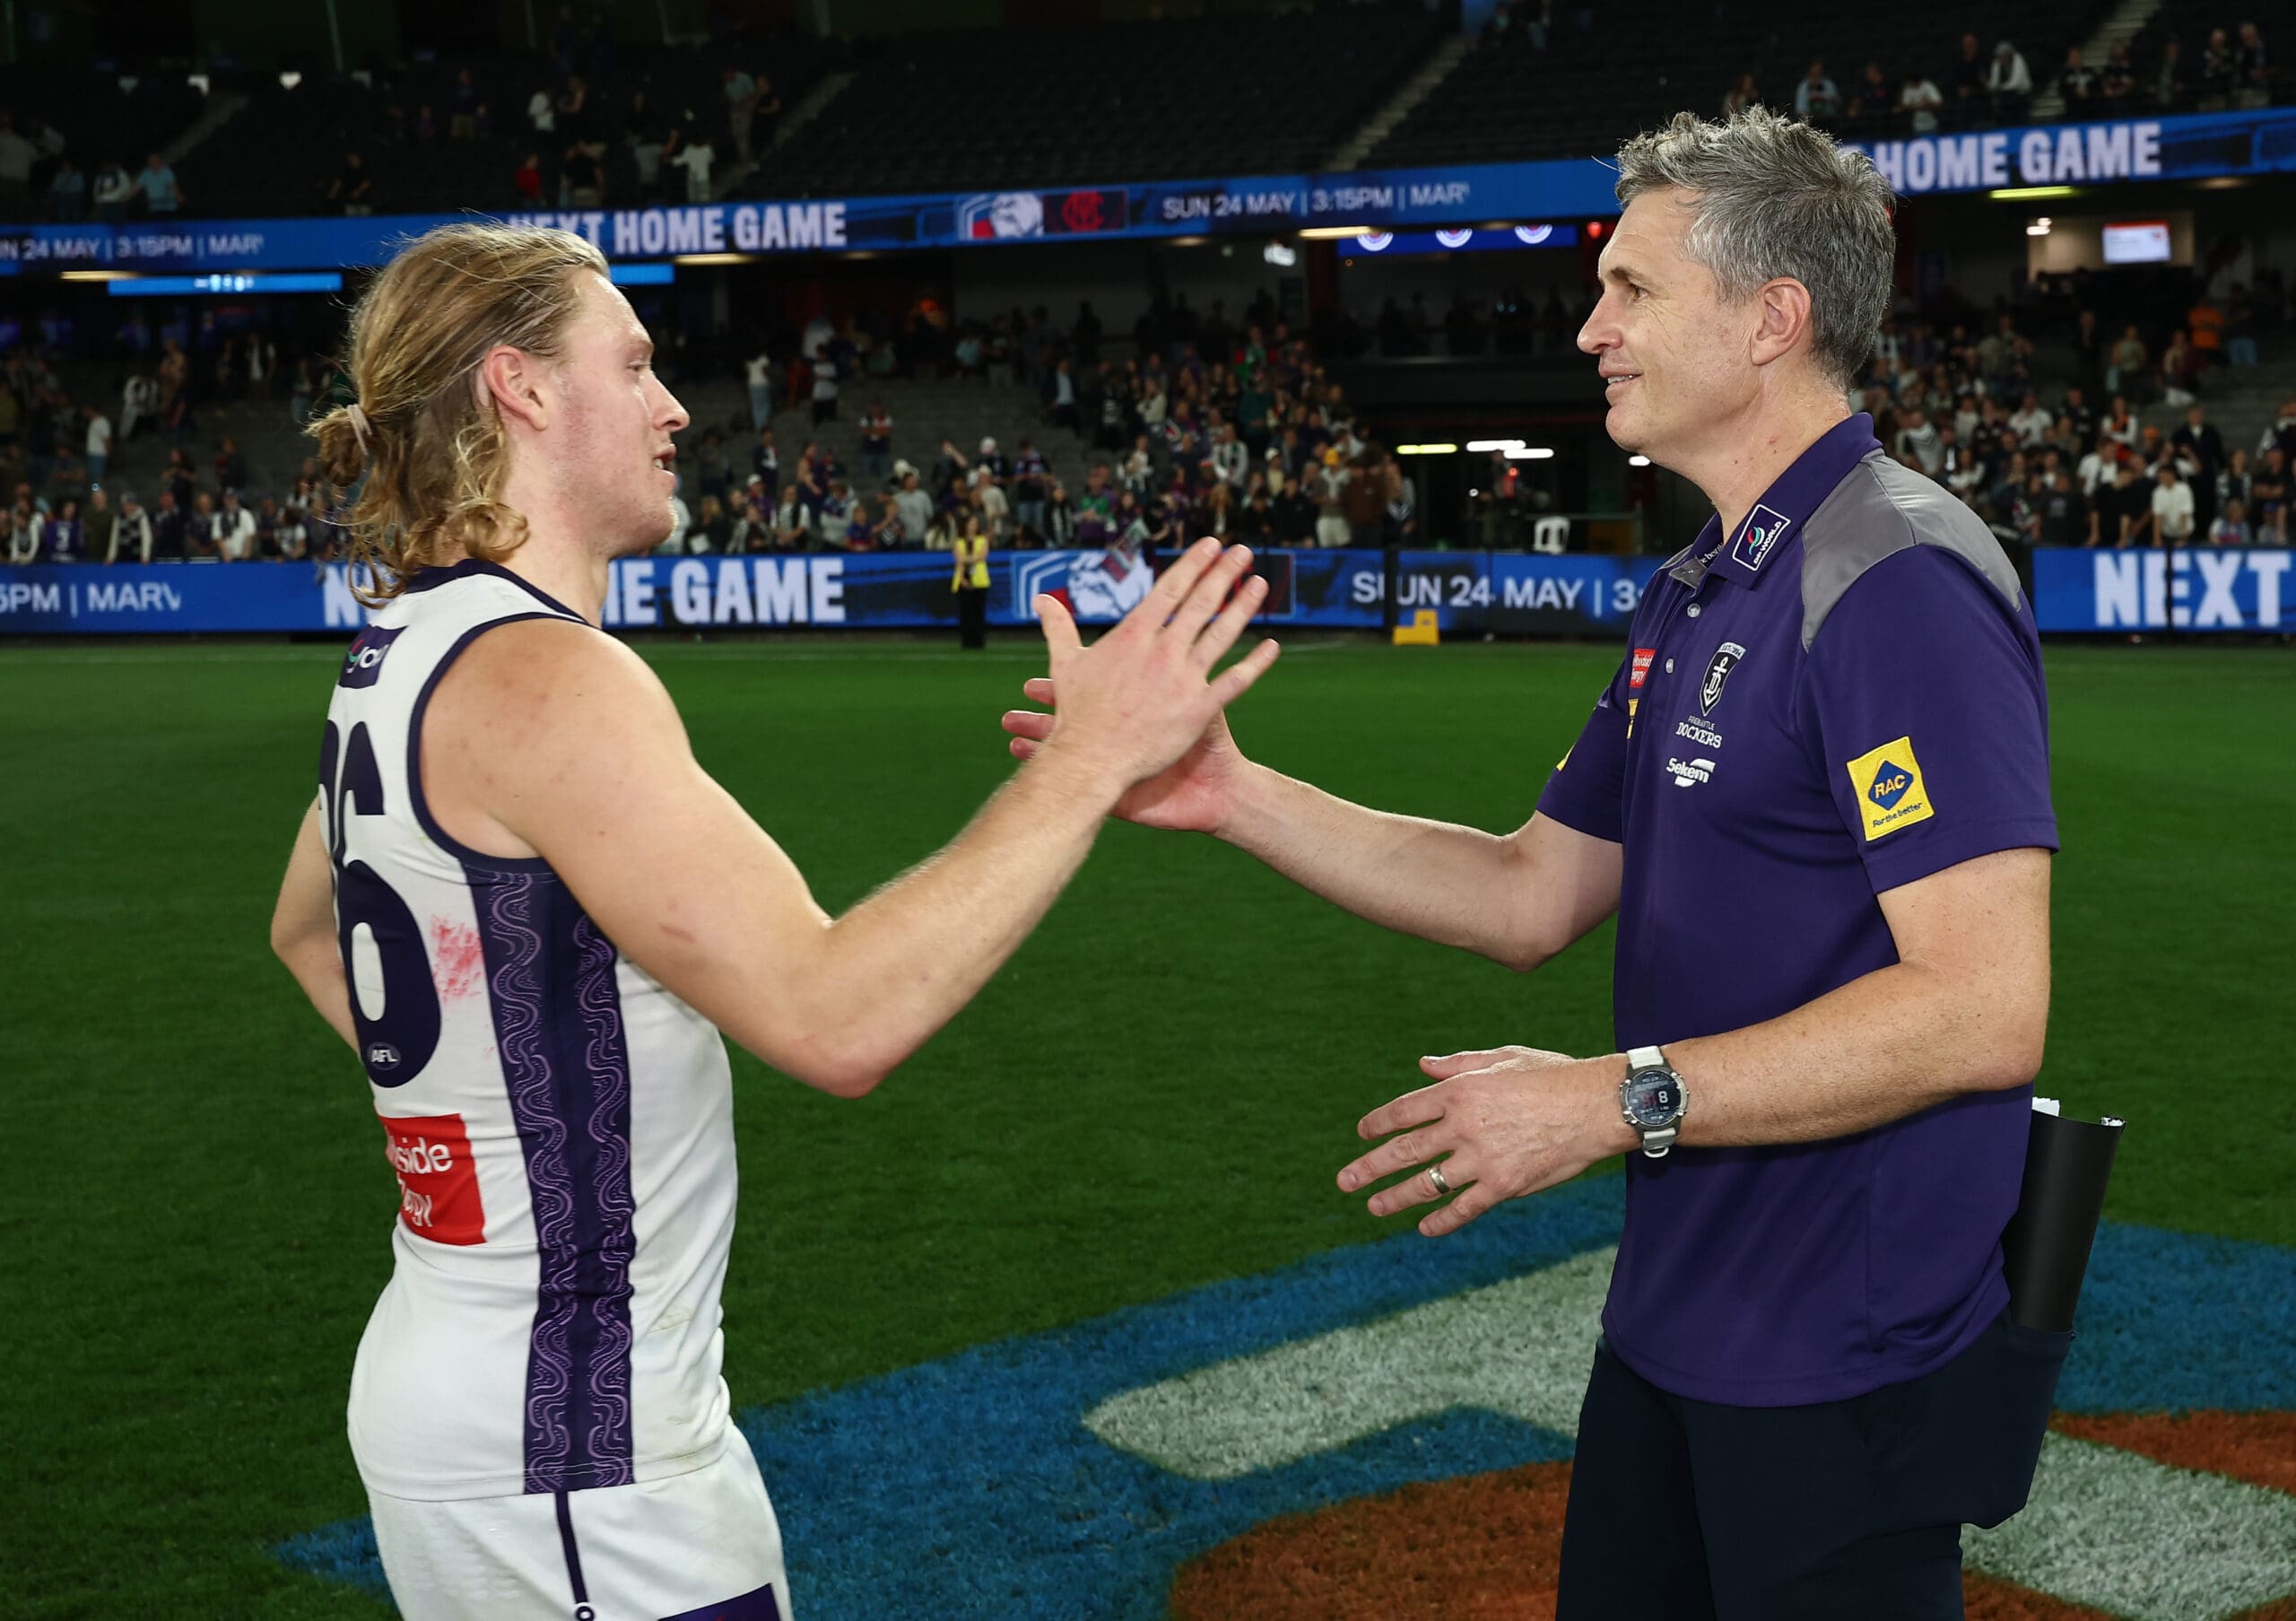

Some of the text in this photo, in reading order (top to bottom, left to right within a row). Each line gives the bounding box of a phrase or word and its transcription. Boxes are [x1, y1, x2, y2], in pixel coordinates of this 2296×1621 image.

[1874, 122, 2161, 191] HOME GAME
[1163, 196, 1210, 219] SUN
[1213, 195, 1243, 217] 24
[1246, 192, 1297, 215] MAY
[1312, 186, 1393, 213] 3:15PM
[614, 206, 726, 254] HOME
[734, 201, 847, 250] GAME
[22, 237, 48, 260] 24
[54, 236, 100, 259] MAY
[117, 233, 193, 258] 3:15PM
[1760, 521, 1782, 552] WORLD
[671, 557, 846, 624] GAME
[1449, 575, 1491, 607] 24
[1503, 577, 1584, 610] MAY
[2094, 551, 2292, 627] NEXT
[1675, 721, 1723, 749] DOCKERS
[1665, 757, 1710, 783] Sekem
[1874, 774, 1906, 799] RAC
[1873, 818, 1884, 828] For
[1897, 802, 1923, 817] better
[371, 1049, 399, 1065] AFL
[386, 1129, 453, 1175] side
